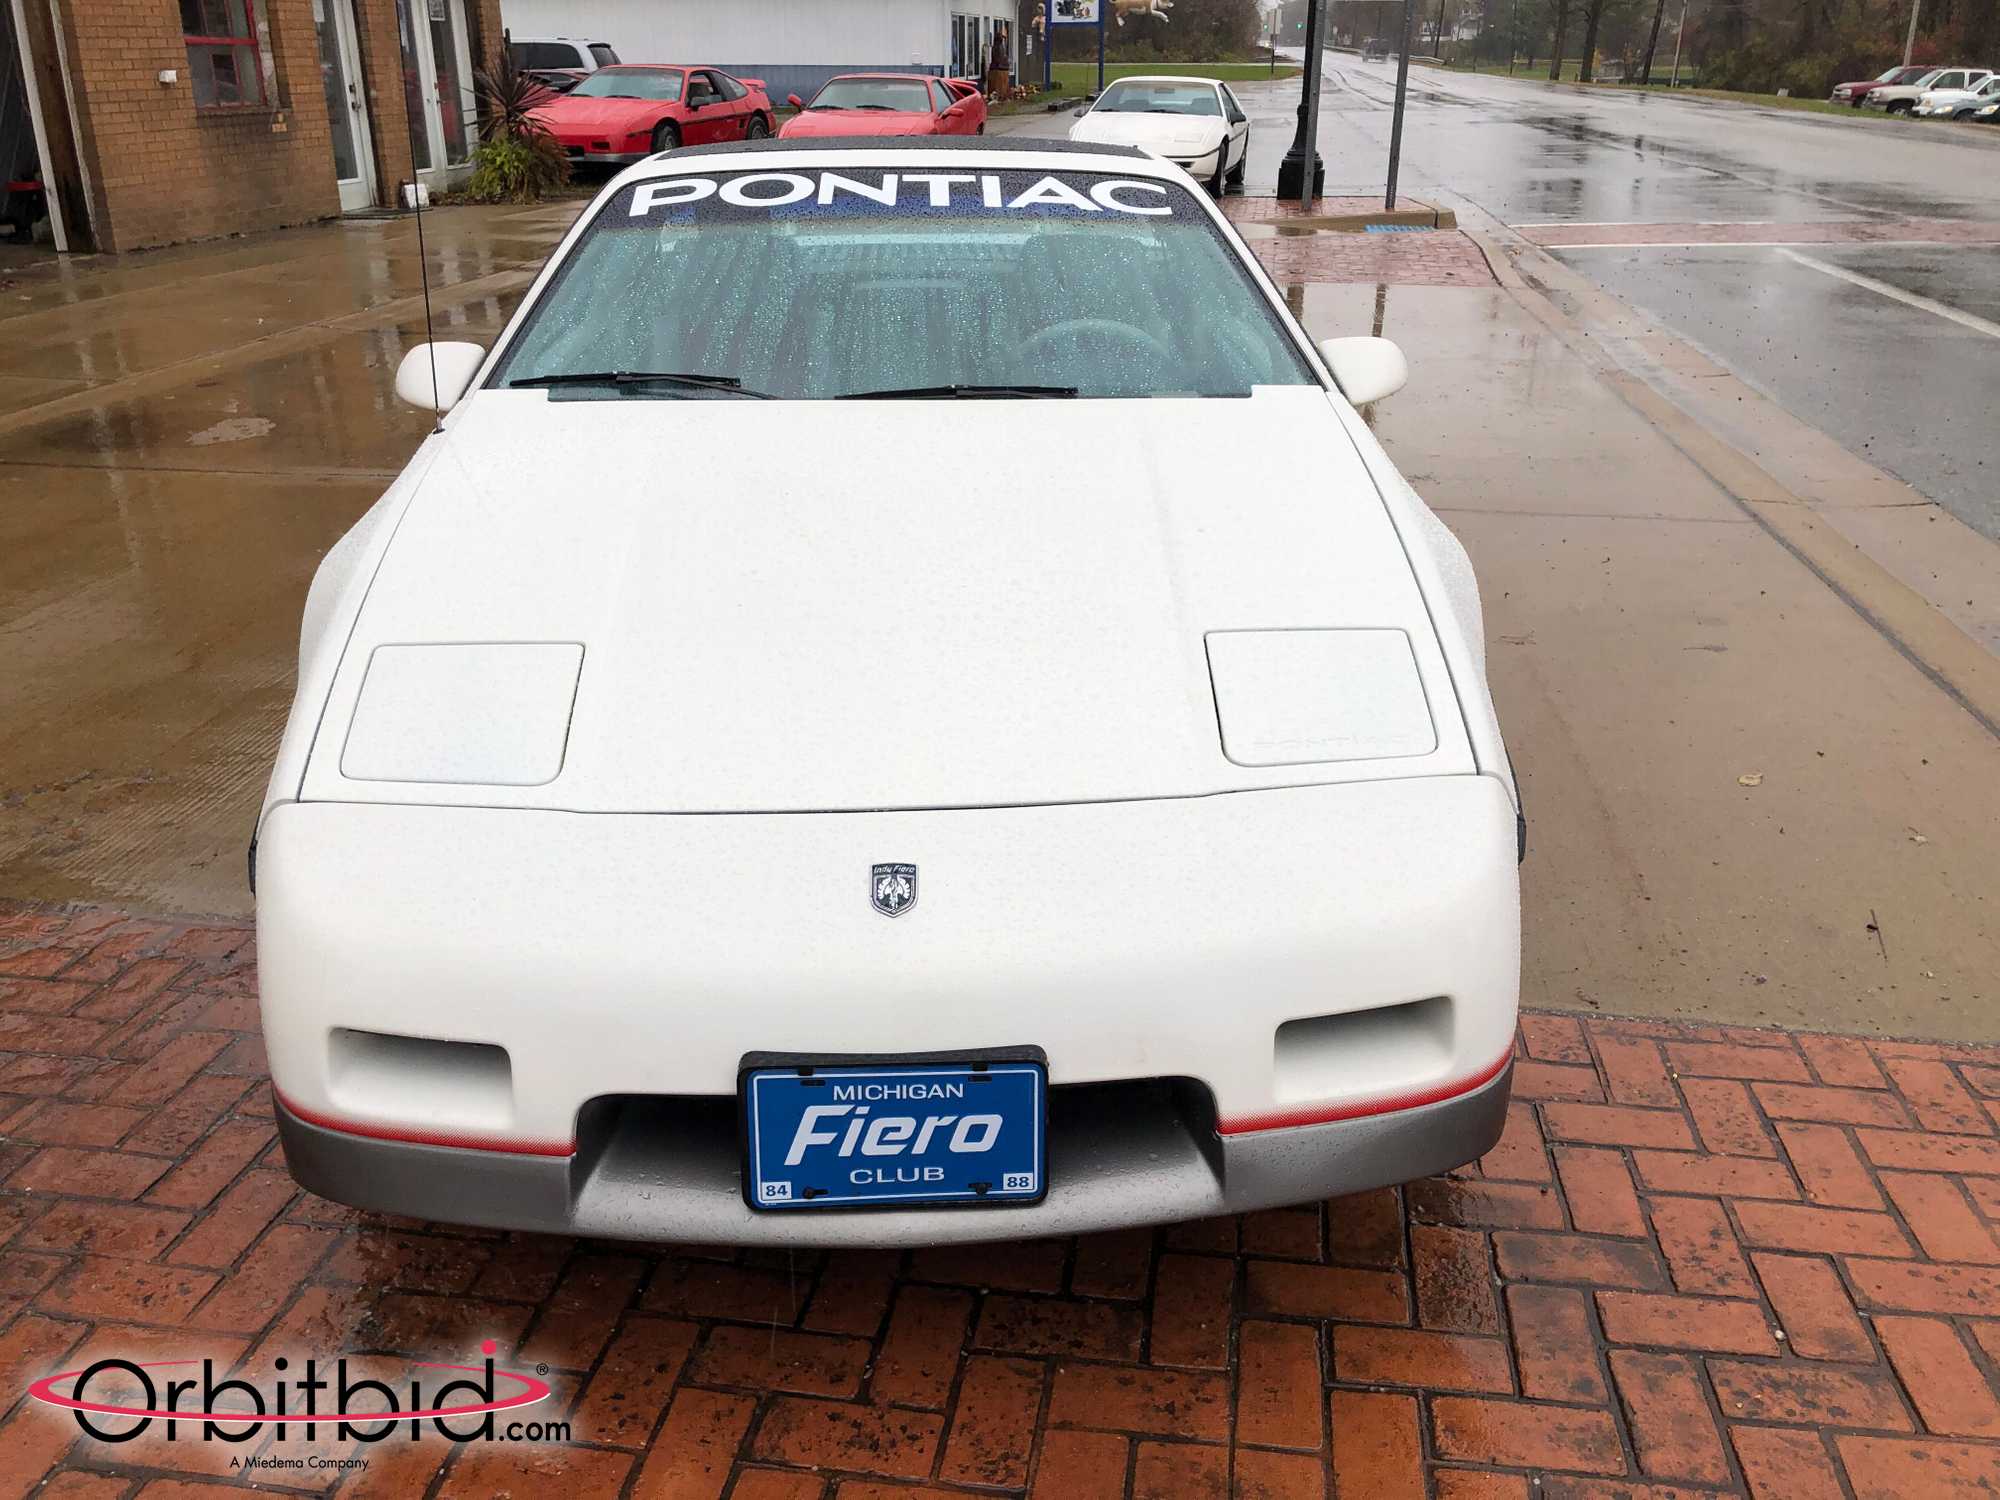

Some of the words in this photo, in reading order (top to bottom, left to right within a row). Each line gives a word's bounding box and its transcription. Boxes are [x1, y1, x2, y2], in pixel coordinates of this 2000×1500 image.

[628, 172, 1173, 217] PONTIAC
[873, 866, 893, 874] Indy
[893, 865, 915, 873] Fiero
[832, 1083, 964, 1101] MICHIGAN
[783, 1104, 1003, 1166] Fiero
[849, 1167, 945, 1185] CLUB
[1006, 1176, 1030, 1189] 88
[765, 1184, 788, 1197] 84
